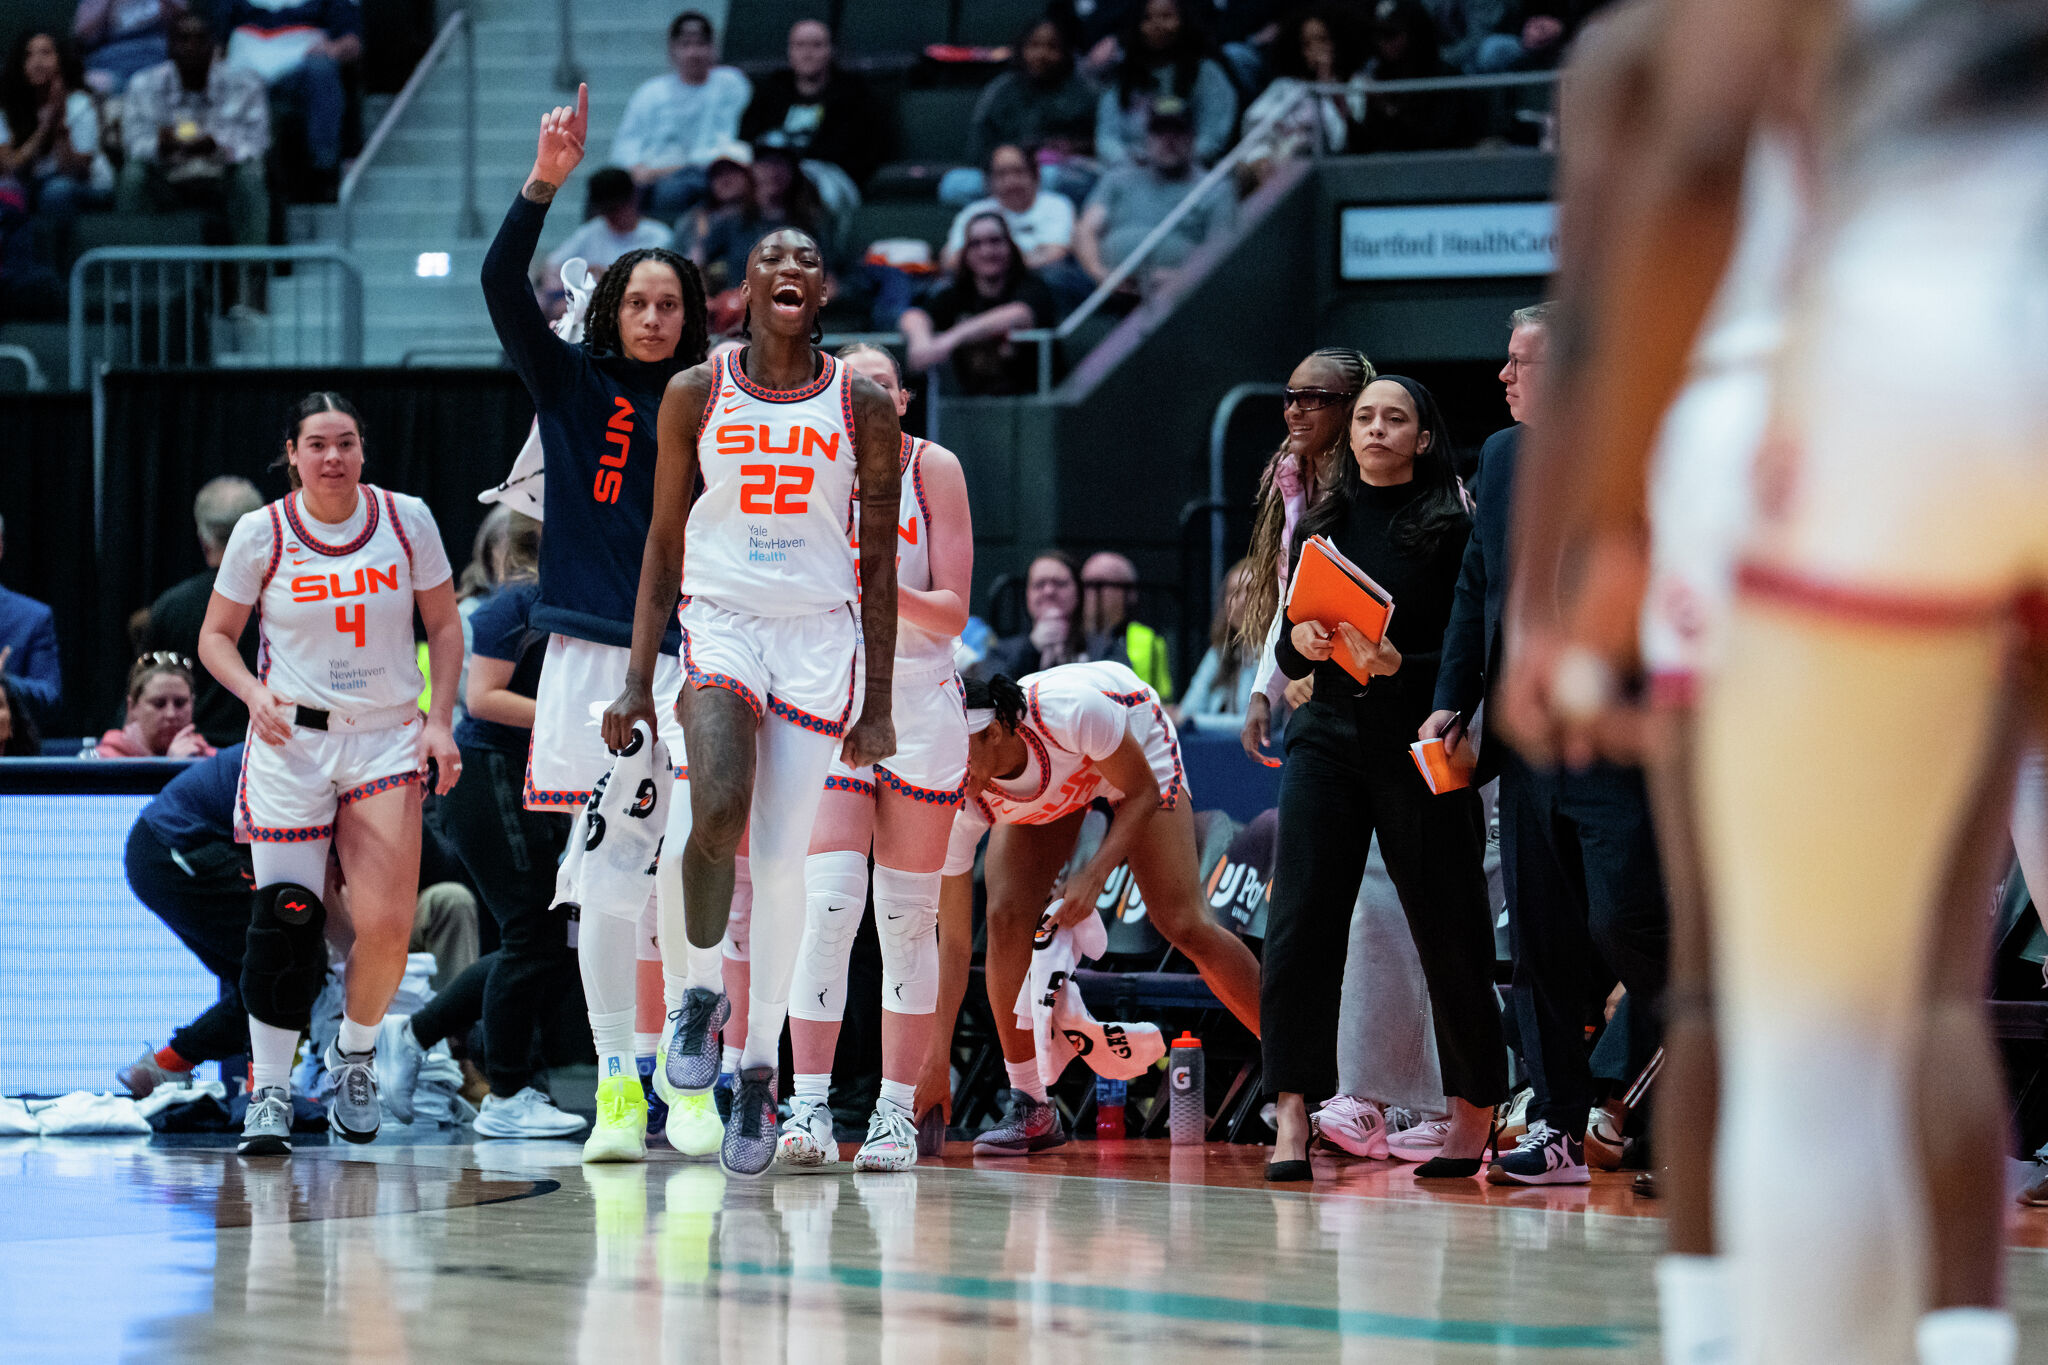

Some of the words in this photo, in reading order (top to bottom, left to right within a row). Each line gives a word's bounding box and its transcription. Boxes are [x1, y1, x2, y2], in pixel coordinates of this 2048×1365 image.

[593, 396, 635, 504] SUN
[716, 424, 840, 461] SUN
[740, 464, 815, 514] 22
[748, 524, 768, 536] Yale
[749, 537, 805, 549] NewHaven
[748, 550, 786, 562] Health
[291, 564, 398, 602] SUN
[335, 603, 366, 648] 4
[328, 659, 349, 669] Yale
[330, 666, 385, 681] NewHaven
[331, 679, 367, 690] Health
[1172, 1066, 1191, 1090] G
